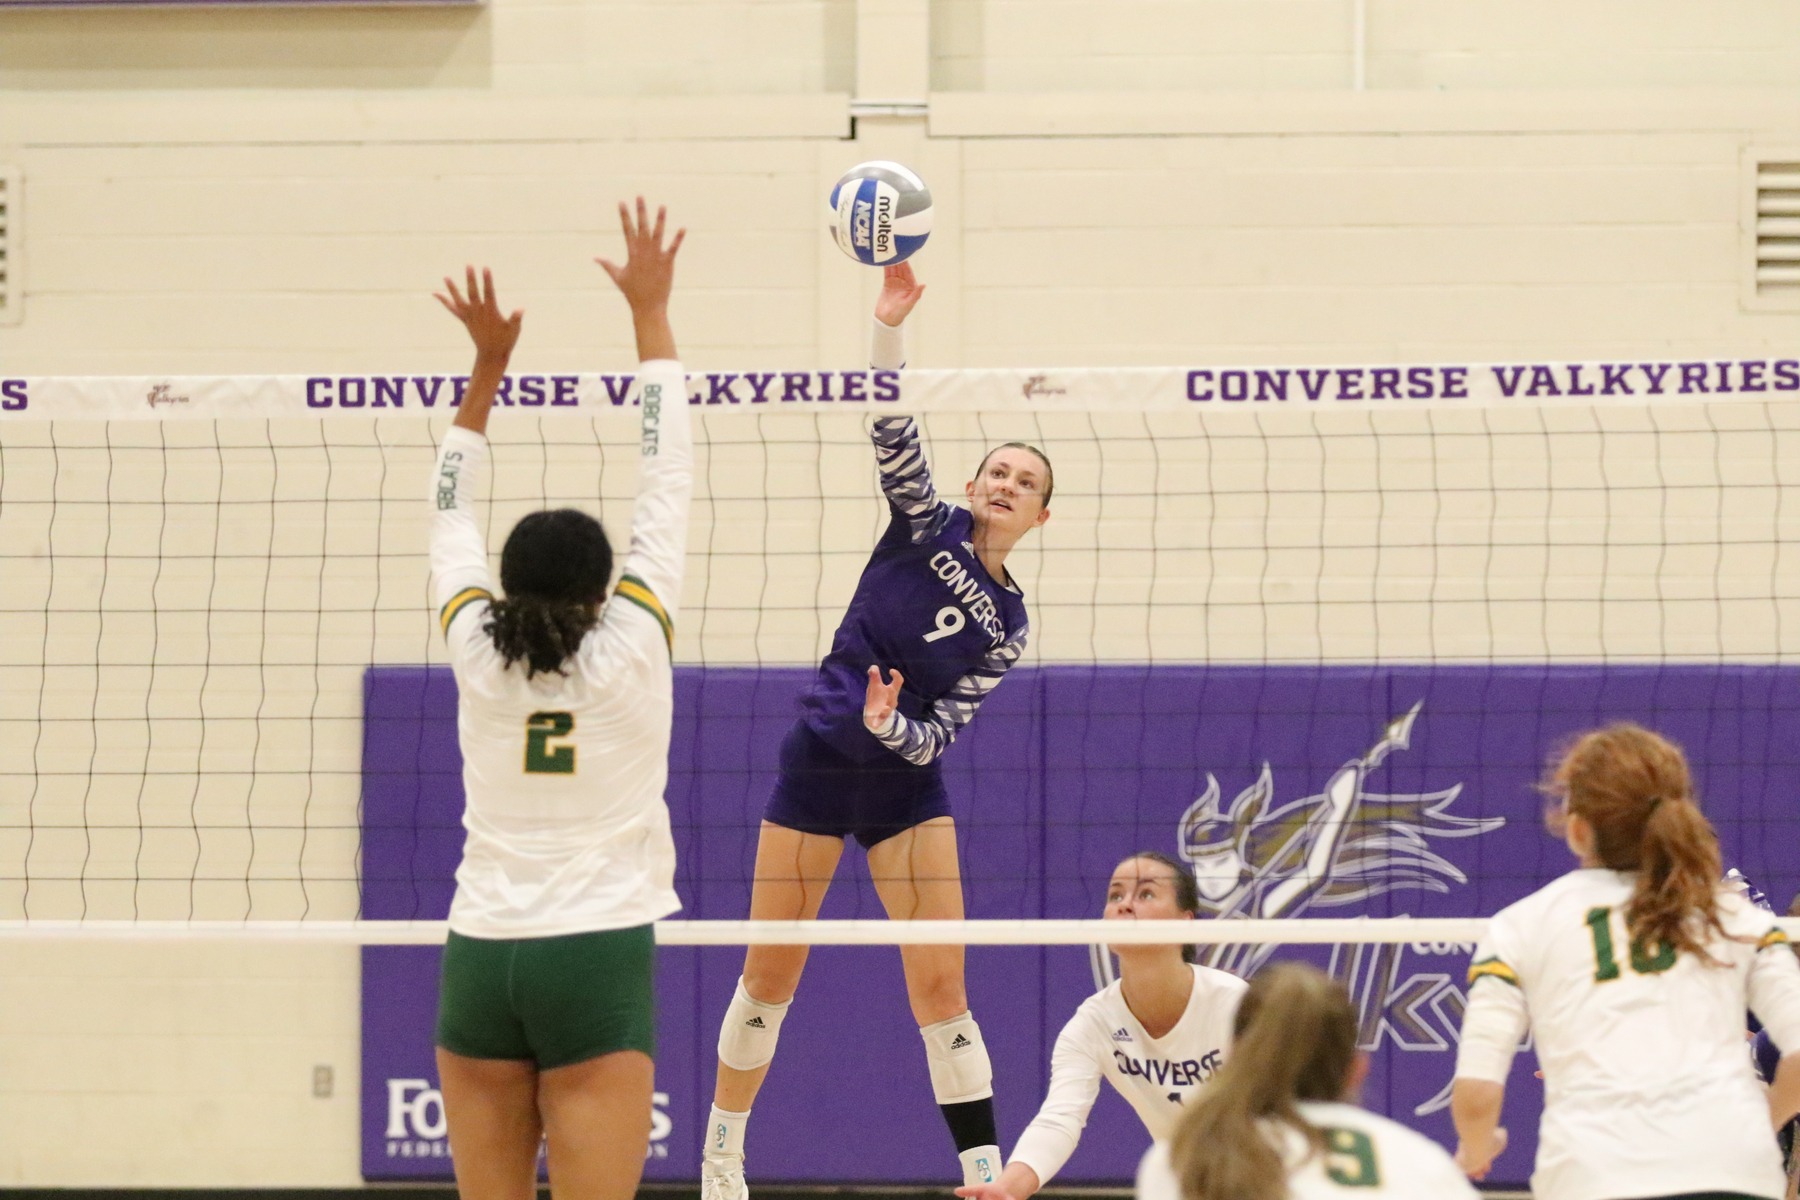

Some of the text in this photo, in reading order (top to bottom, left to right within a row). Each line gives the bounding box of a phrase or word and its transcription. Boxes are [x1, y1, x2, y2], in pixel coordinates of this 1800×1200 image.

[854, 199, 872, 250] NCAA
[877, 195, 892, 253] molten
[601, 371, 900, 406] VKYRIES
[1186, 360, 1800, 402] CONVERSE VALKYRIES
[642, 384, 662, 456] BOBCATS
[922, 605, 966, 643] 9
[523, 710, 577, 776] 2
[1321, 1126, 1385, 1191] 9
